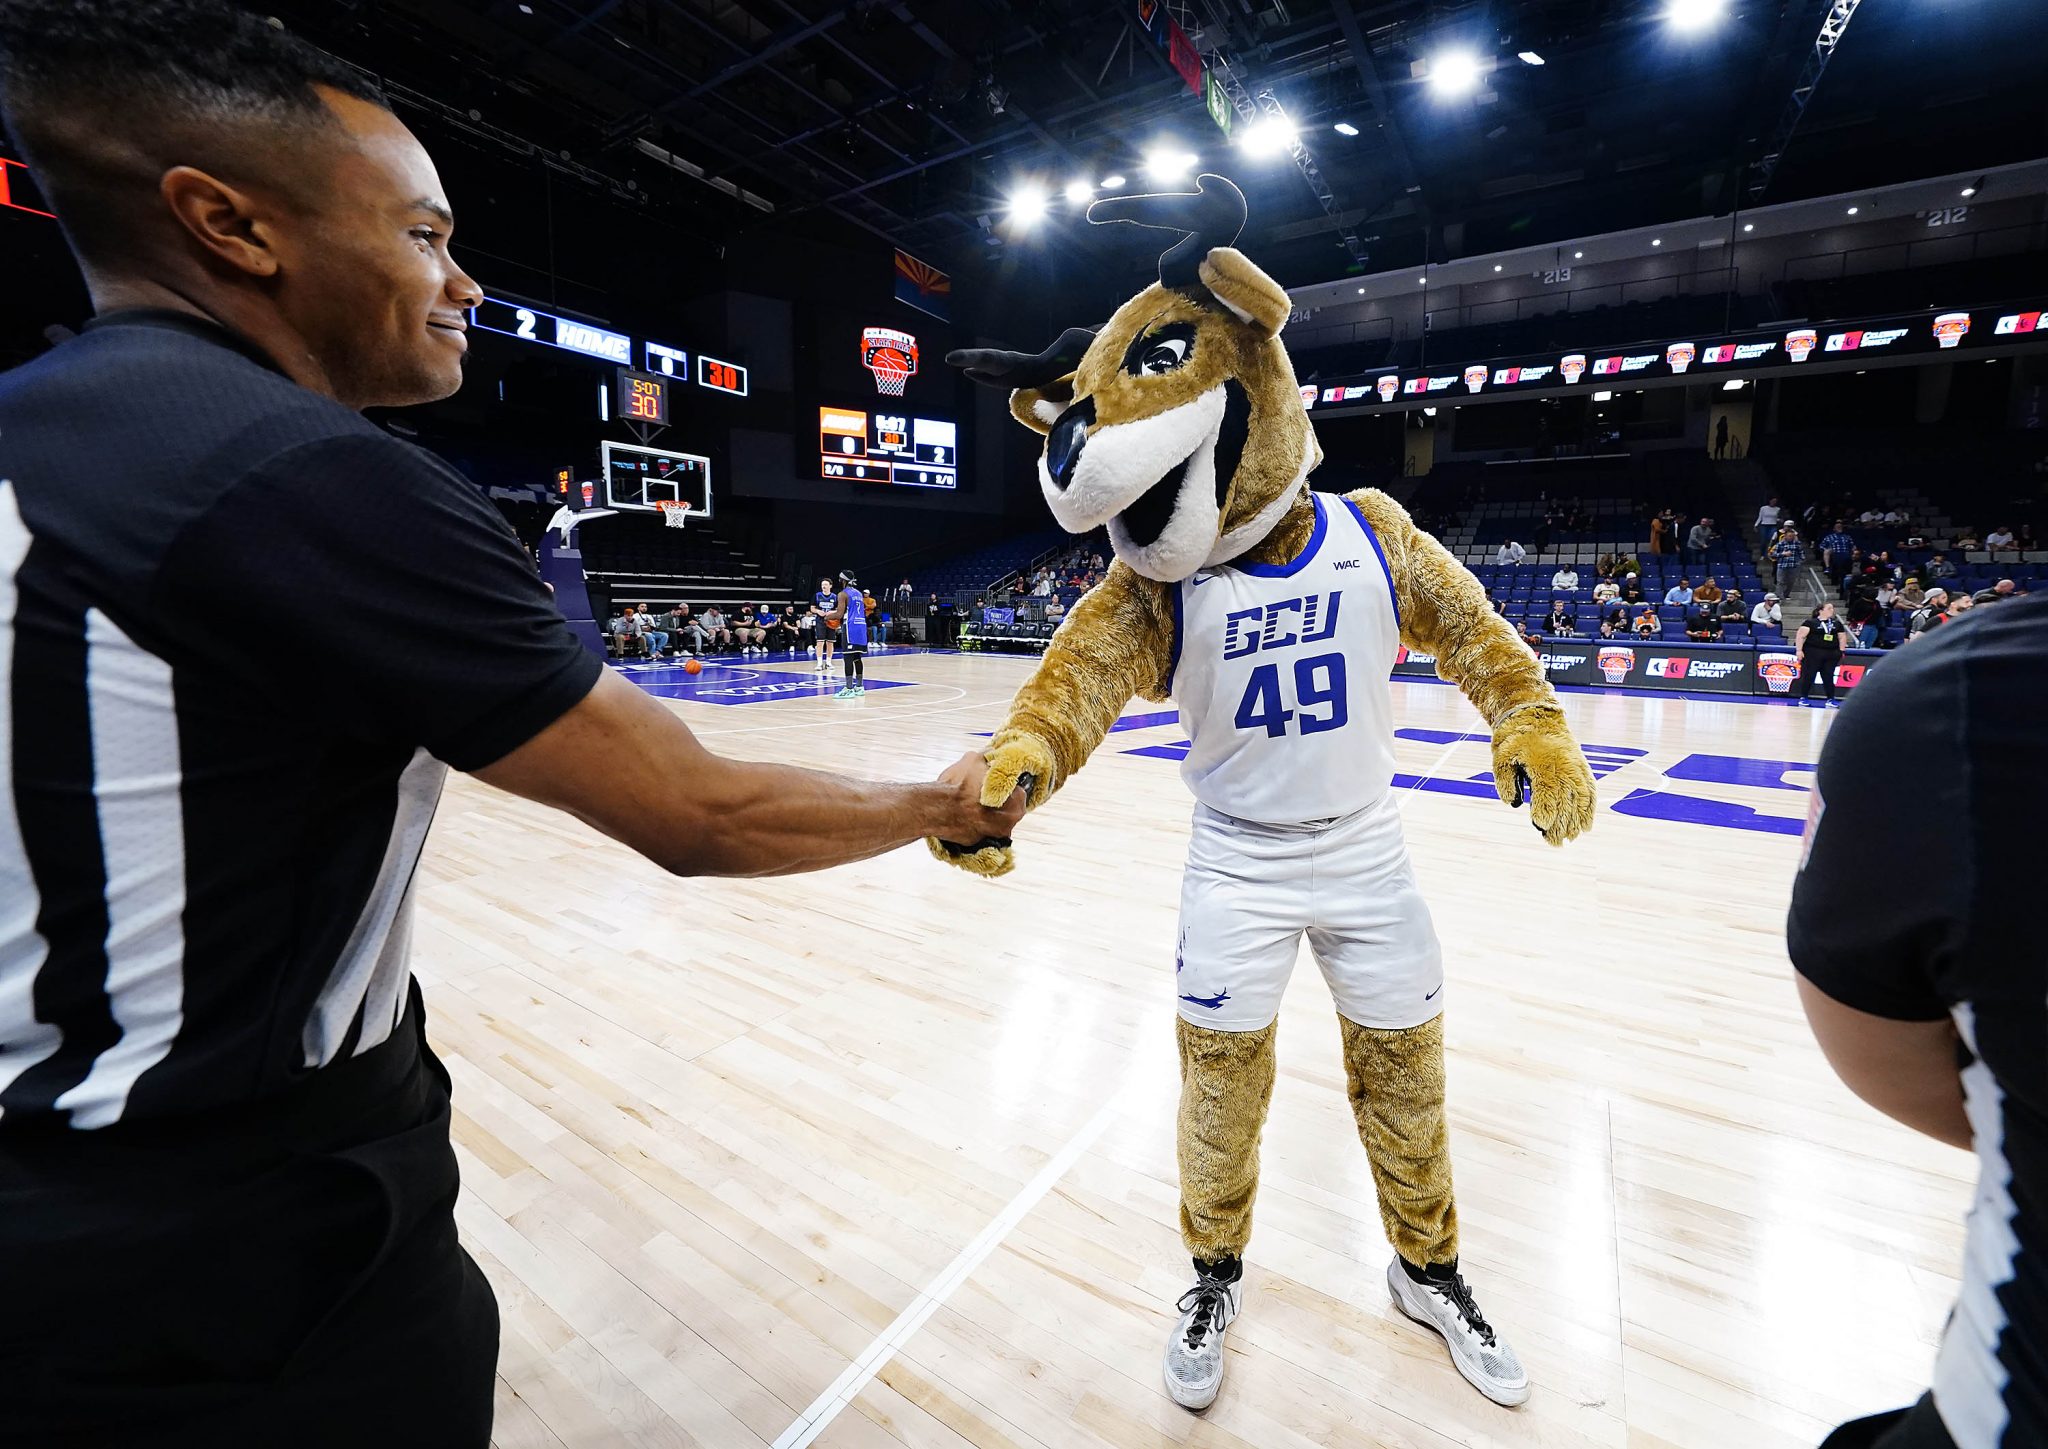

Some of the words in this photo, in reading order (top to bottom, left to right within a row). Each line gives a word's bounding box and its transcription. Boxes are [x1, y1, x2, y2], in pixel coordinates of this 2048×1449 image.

[1927, 206, 1967, 227] 212
[1544, 268, 1571, 284] 213
[516, 308, 537, 340] 2
[1291, 310, 1312, 324] 214
[556, 323, 631, 360] HOME
[709, 361, 737, 390] 30
[633, 379, 660, 396] 5:07
[631, 392, 658, 418] 30
[884, 432, 900, 444] 30
[933, 446, 946, 464] 2
[1333, 559, 1361, 571] WAC
[1223, 590, 1343, 661] GCU
[1690, 660, 1745, 672] CELEBRITY
[1234, 652, 1348, 739] 49
